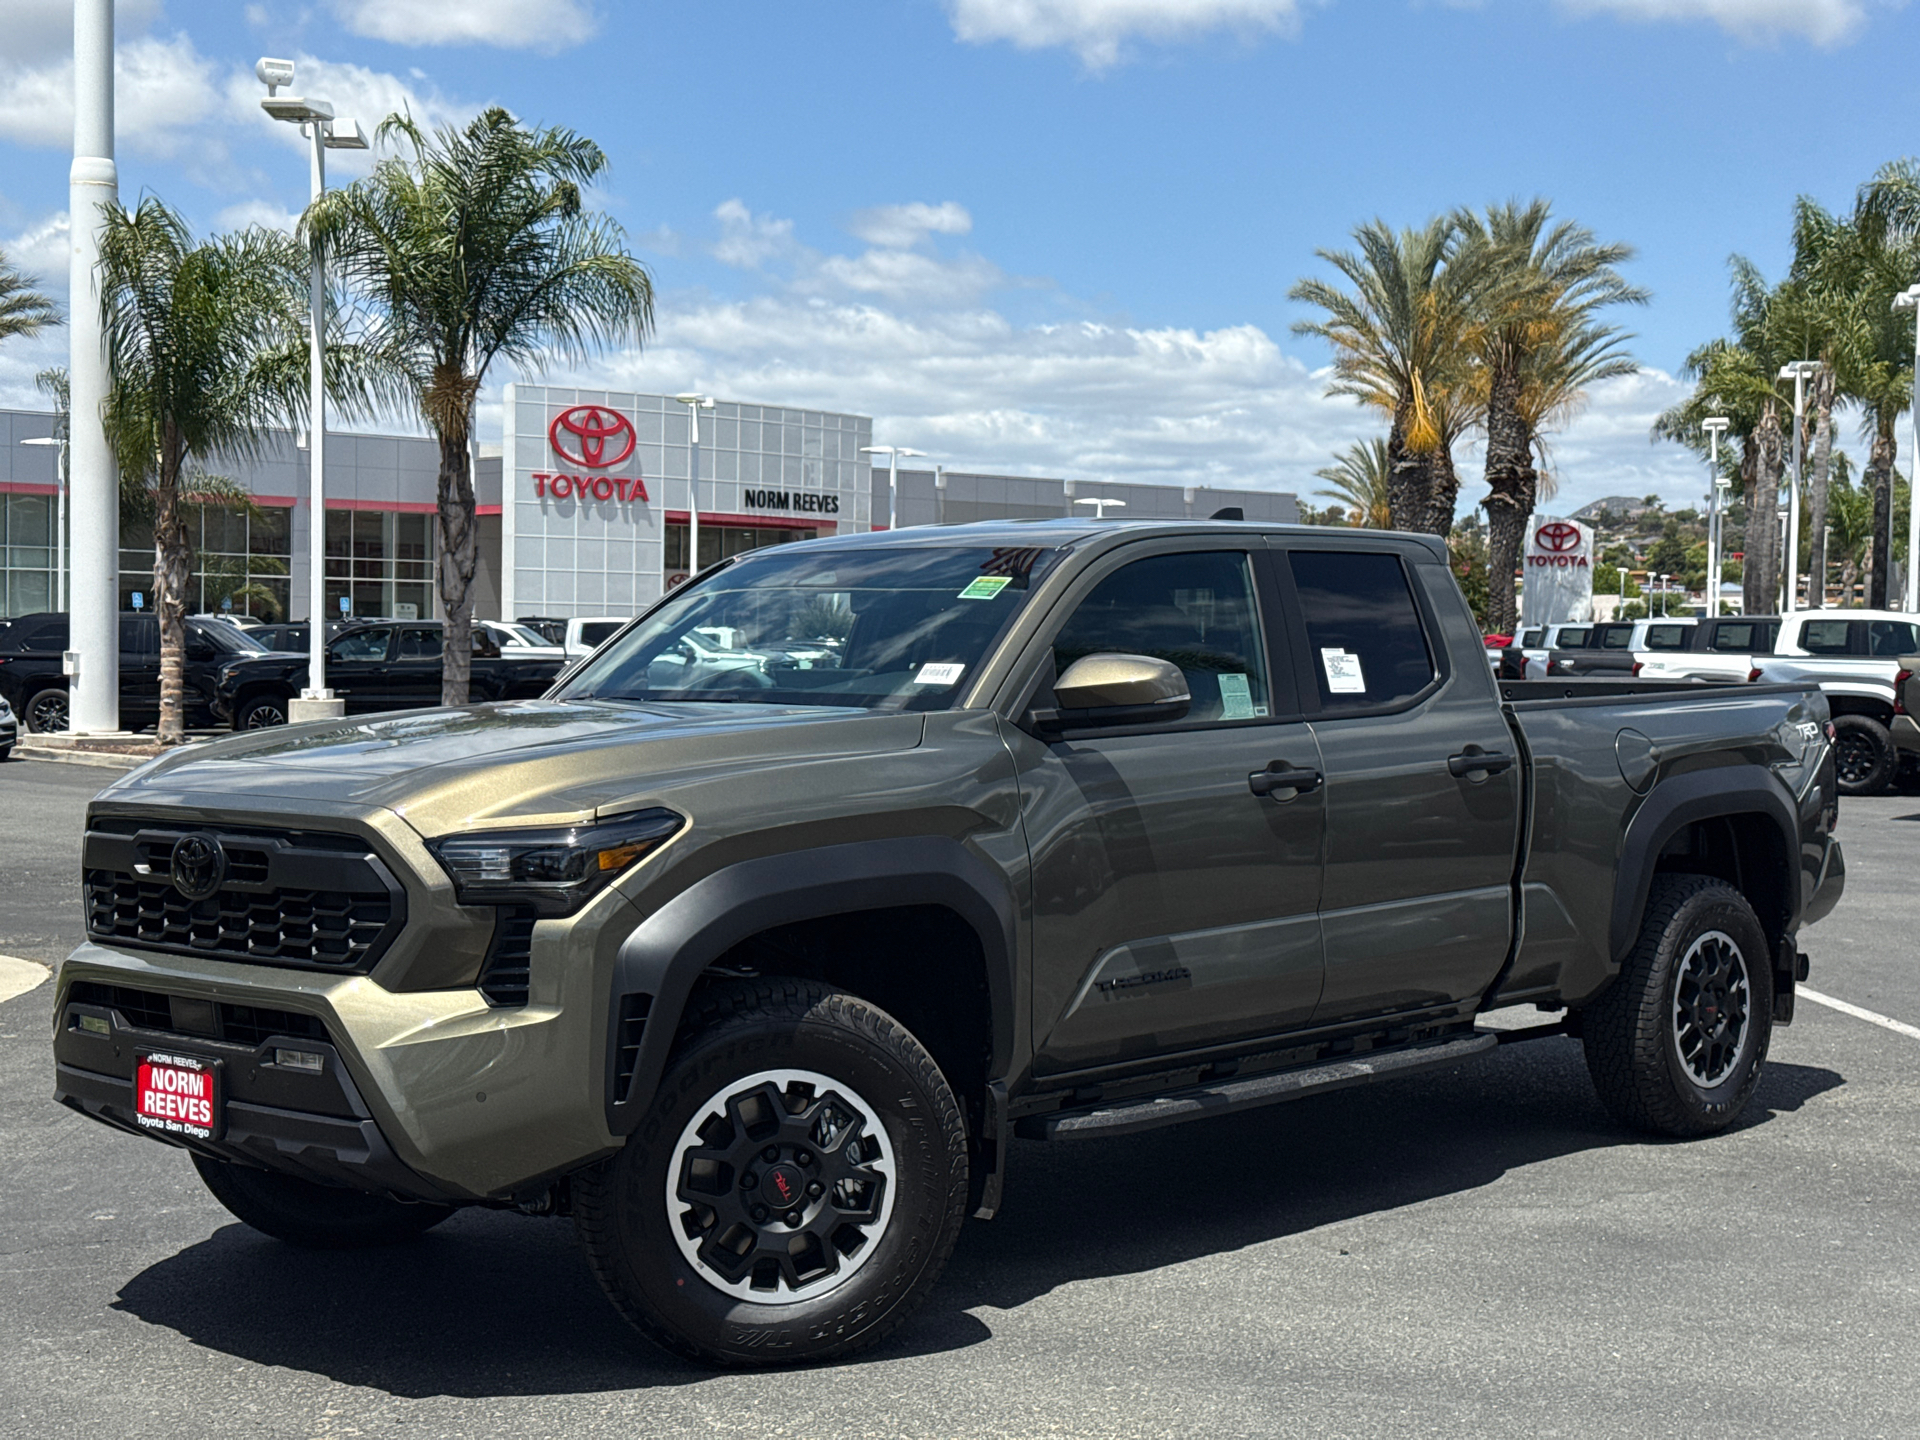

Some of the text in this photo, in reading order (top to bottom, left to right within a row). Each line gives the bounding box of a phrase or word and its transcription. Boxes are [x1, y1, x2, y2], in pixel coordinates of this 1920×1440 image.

[532, 473, 649, 502] TOYOTA
[744, 489, 839, 514] NORM REEVES
[1526, 555, 1588, 567] TOYOTA
[1795, 721, 1819, 740] TRD
[152, 1053, 197, 1069] NORM REEVES
[151, 1067, 204, 1097] NORM
[144, 1090, 211, 1123] REEVES
[136, 1114, 210, 1138] Toyota San Diego
